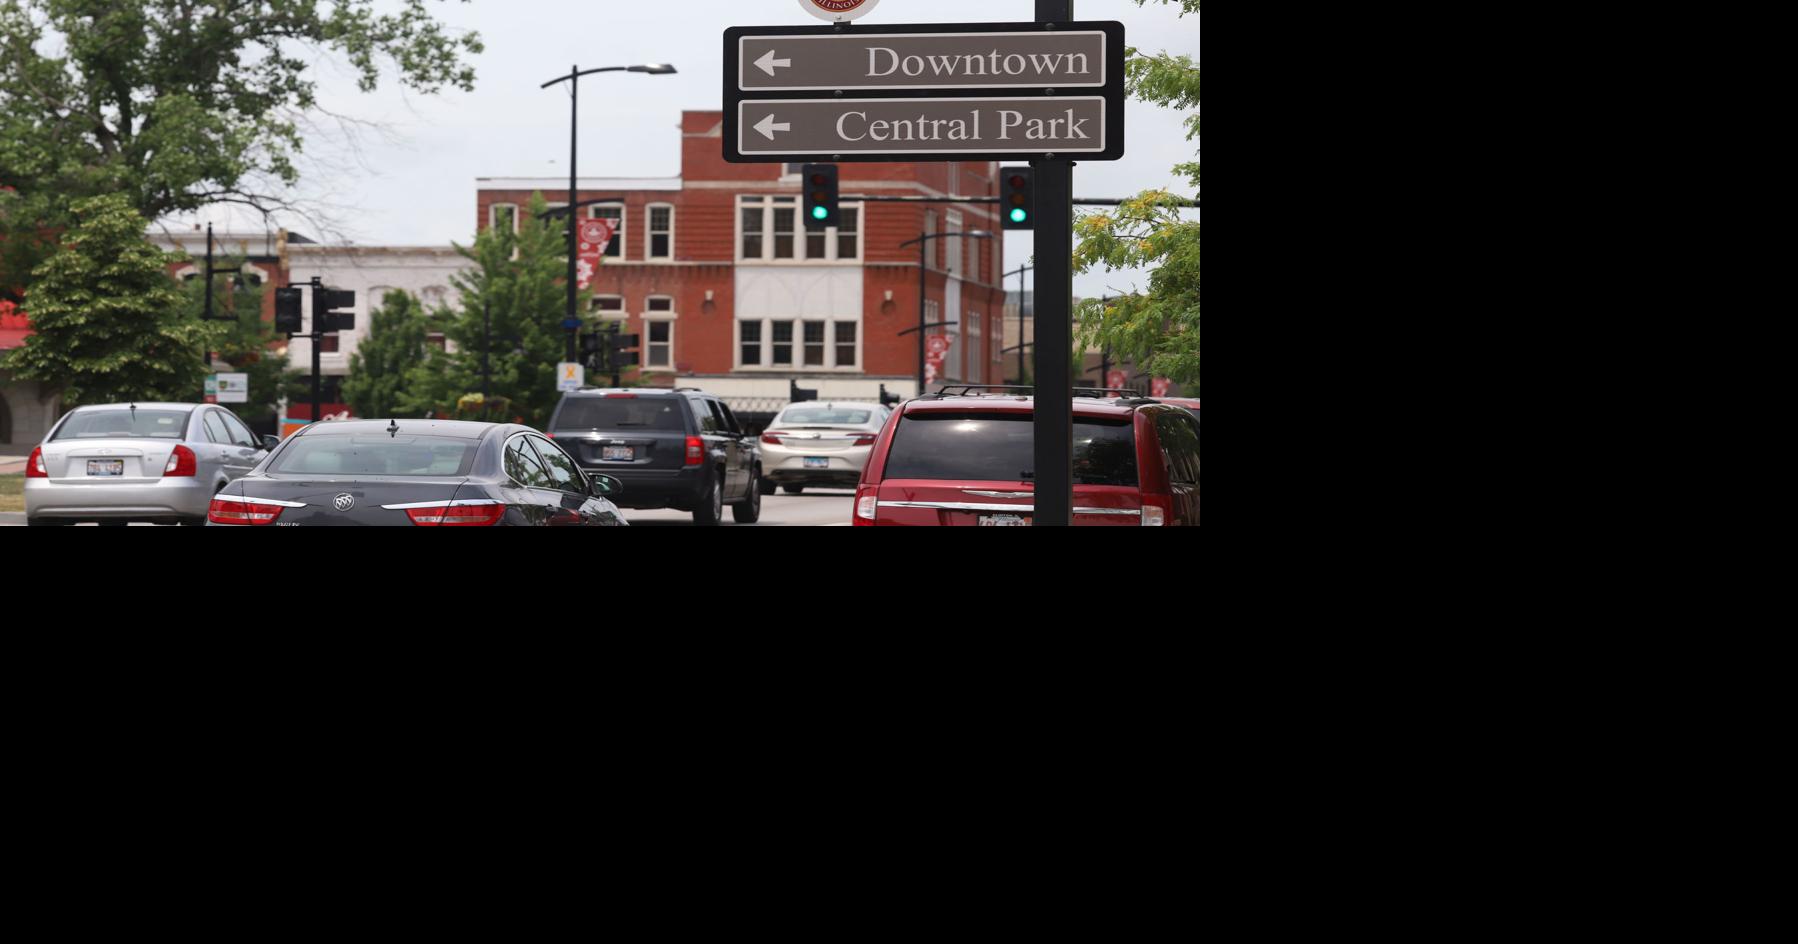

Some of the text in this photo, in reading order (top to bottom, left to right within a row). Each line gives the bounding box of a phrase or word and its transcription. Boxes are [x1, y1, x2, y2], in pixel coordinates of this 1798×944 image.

[865, 47, 1090, 77] Downtown
[836, 108, 1090, 141] Central Park
